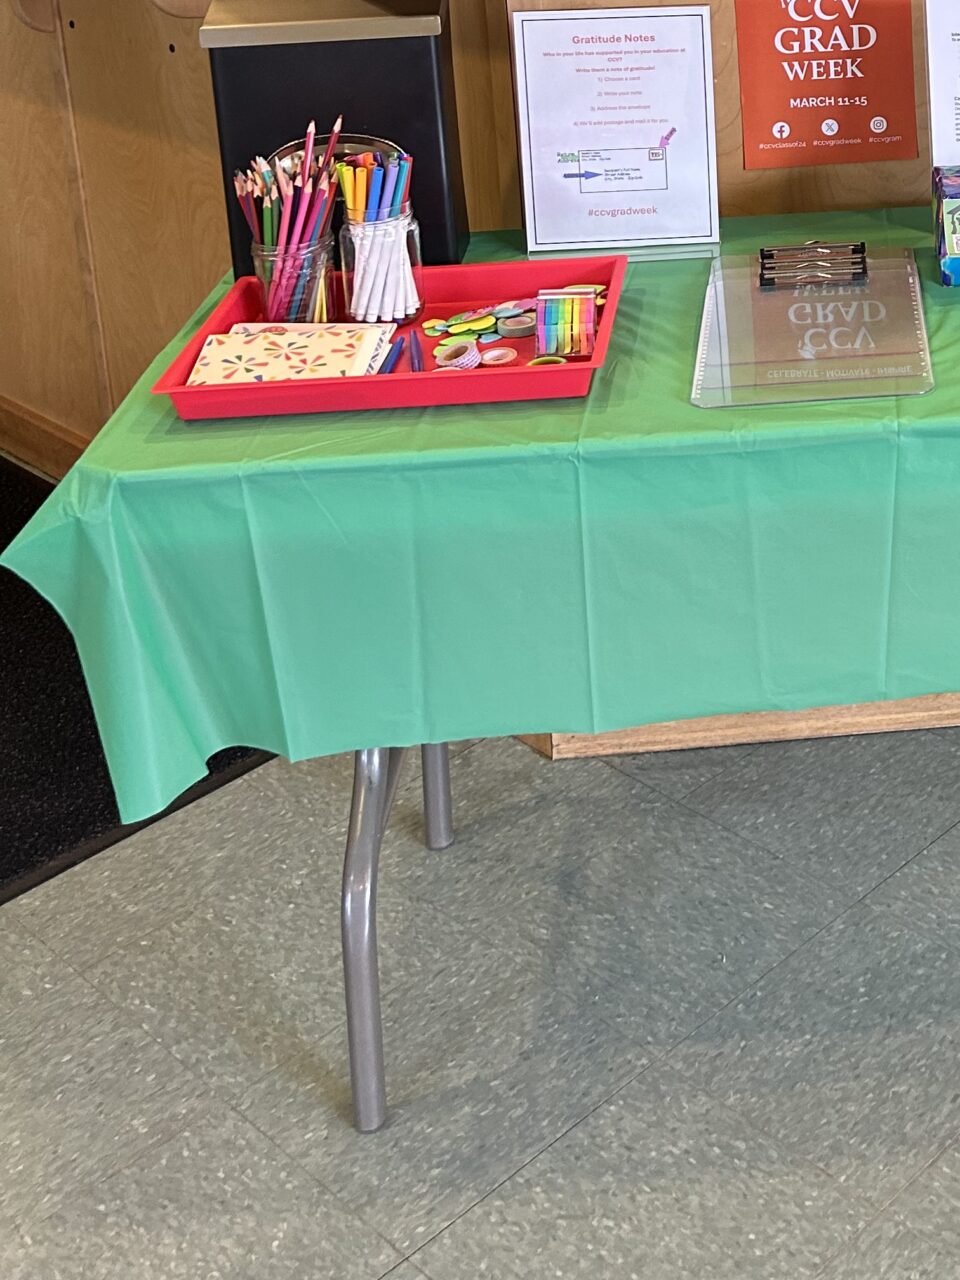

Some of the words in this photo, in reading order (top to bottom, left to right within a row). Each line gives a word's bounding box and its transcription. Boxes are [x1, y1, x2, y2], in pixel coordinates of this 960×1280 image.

[572, 35, 622, 44] Gratitude
[624, 34, 656, 43] Notes
[774, 24, 877, 54] GRAD
[781, 58, 864, 81] WEEK
[790, 96, 834, 108] MARCH
[837, 96, 868, 106] 11-15
[869, 134, 902, 143] #ccvgram
[588, 206, 658, 217] #ccvgradweek
